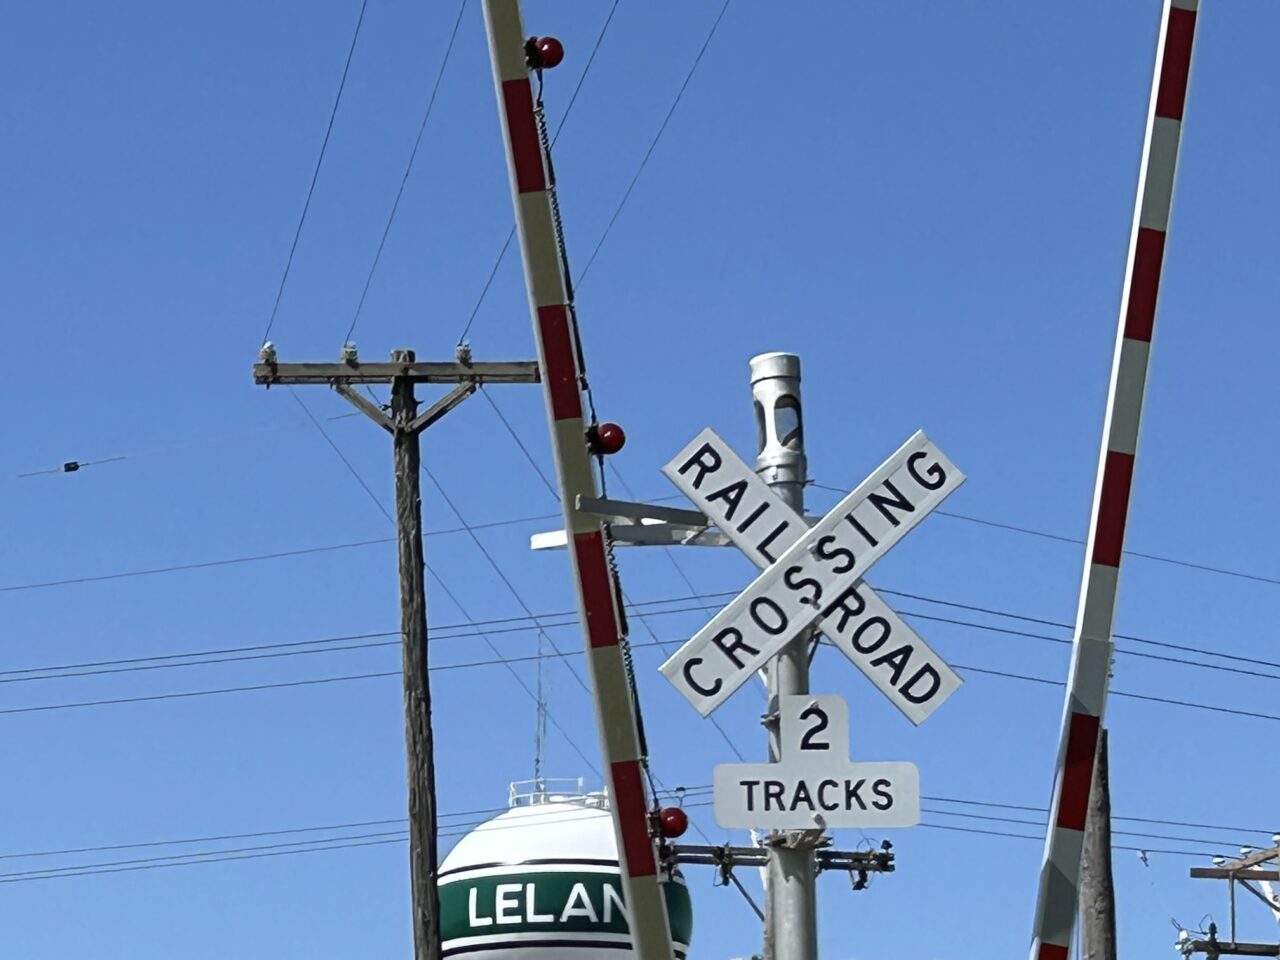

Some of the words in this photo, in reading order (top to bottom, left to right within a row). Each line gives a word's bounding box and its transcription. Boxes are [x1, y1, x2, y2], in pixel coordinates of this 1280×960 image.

[677, 442, 790, 566] RAIL
[820, 586, 942, 705] ROAD
[682, 450, 947, 698] CROSSING
[799, 707, 831, 751] 2
[739, 778, 894, 812] TRACKS
[468, 882, 631, 928] LELAN
